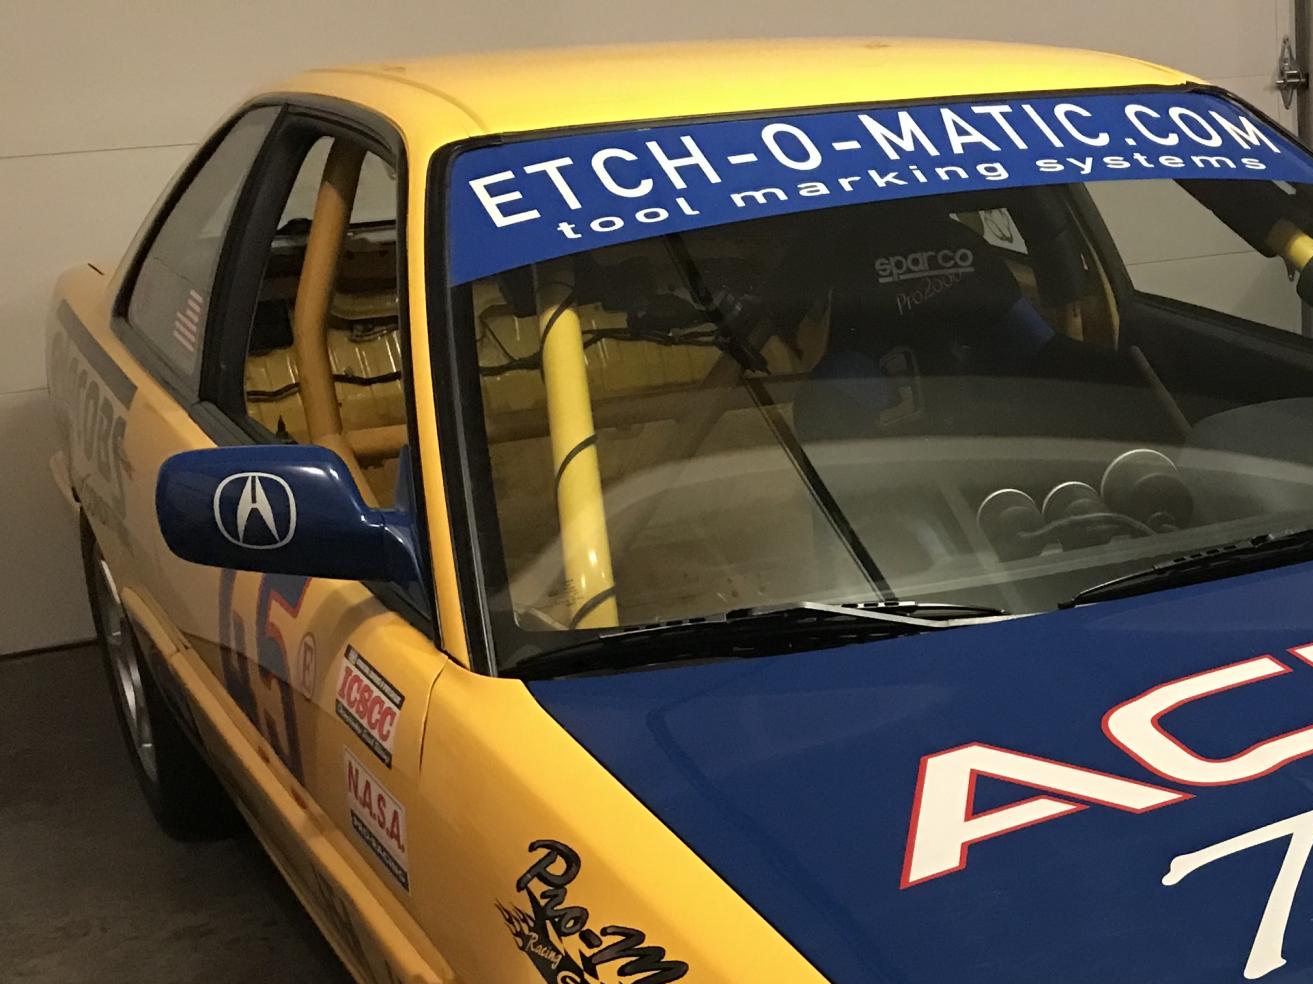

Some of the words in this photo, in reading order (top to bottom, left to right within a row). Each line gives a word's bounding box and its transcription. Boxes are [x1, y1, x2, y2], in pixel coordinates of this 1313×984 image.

[468, 102, 1282, 230] ETCH-O-MATIC.COM
[556, 197, 701, 241] tool
[731, 161, 1007, 208] marking
[1034, 152, 1268, 180] systems
[874, 247, 975, 283] sparco
[337, 666, 397, 743] ICSCC
[525, 931, 563, 969] Racing
